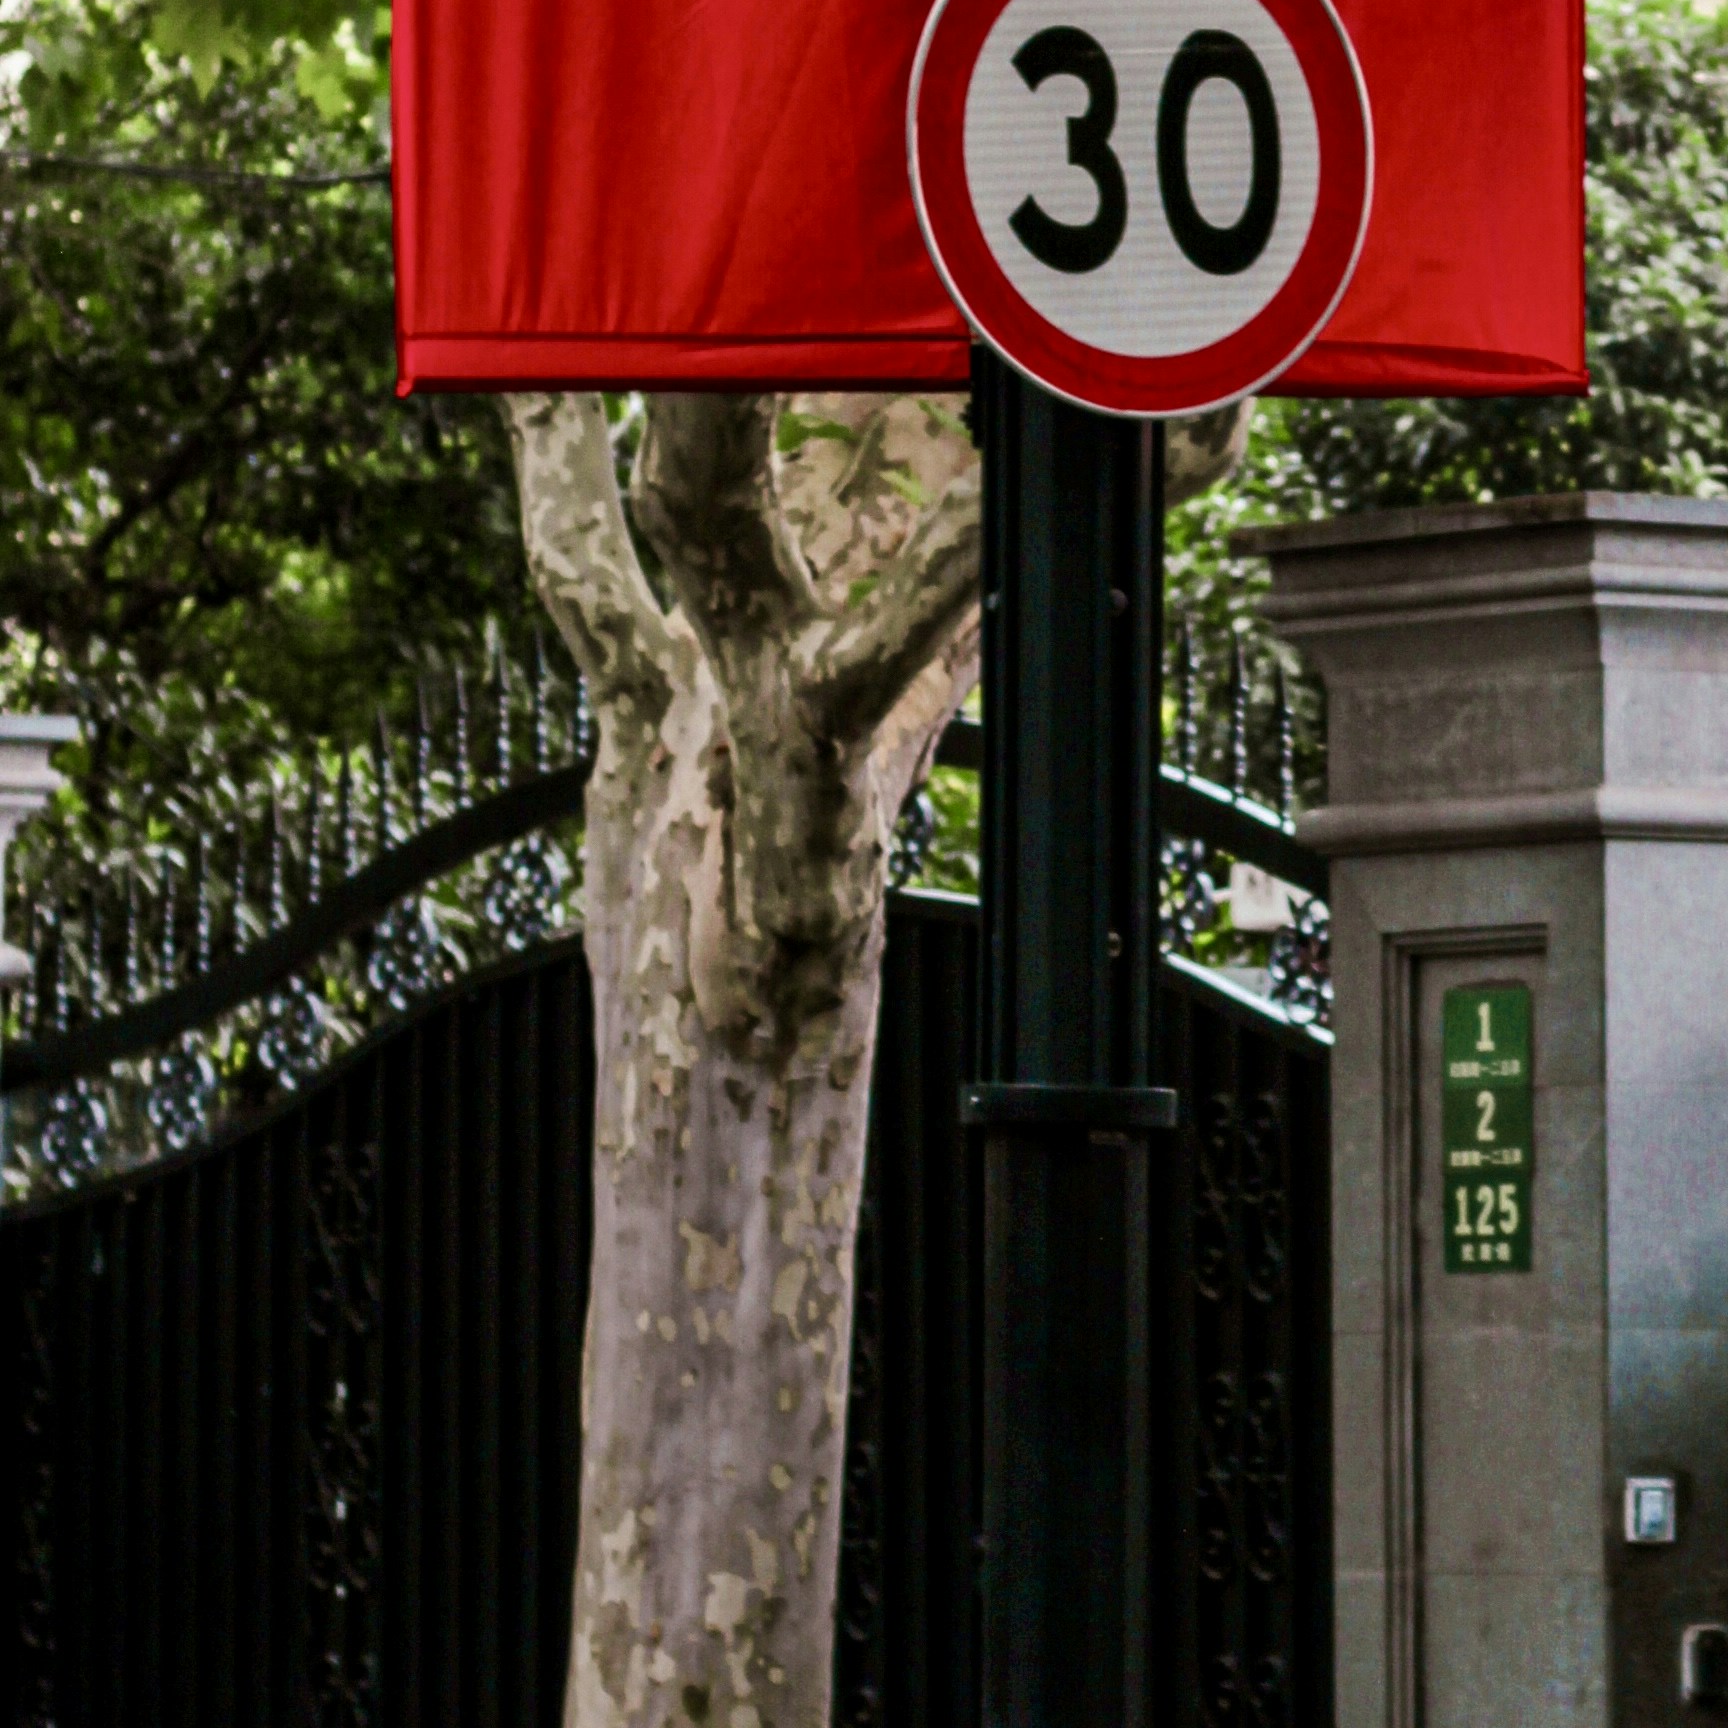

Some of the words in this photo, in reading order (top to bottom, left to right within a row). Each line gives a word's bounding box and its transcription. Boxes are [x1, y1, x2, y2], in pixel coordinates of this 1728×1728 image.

[1008, 25, 1282, 276] 30
[1475, 1001, 1495, 1051] 1
[1476, 1090, 1496, 1141] 2
[1455, 1184, 1519, 1235] 125
